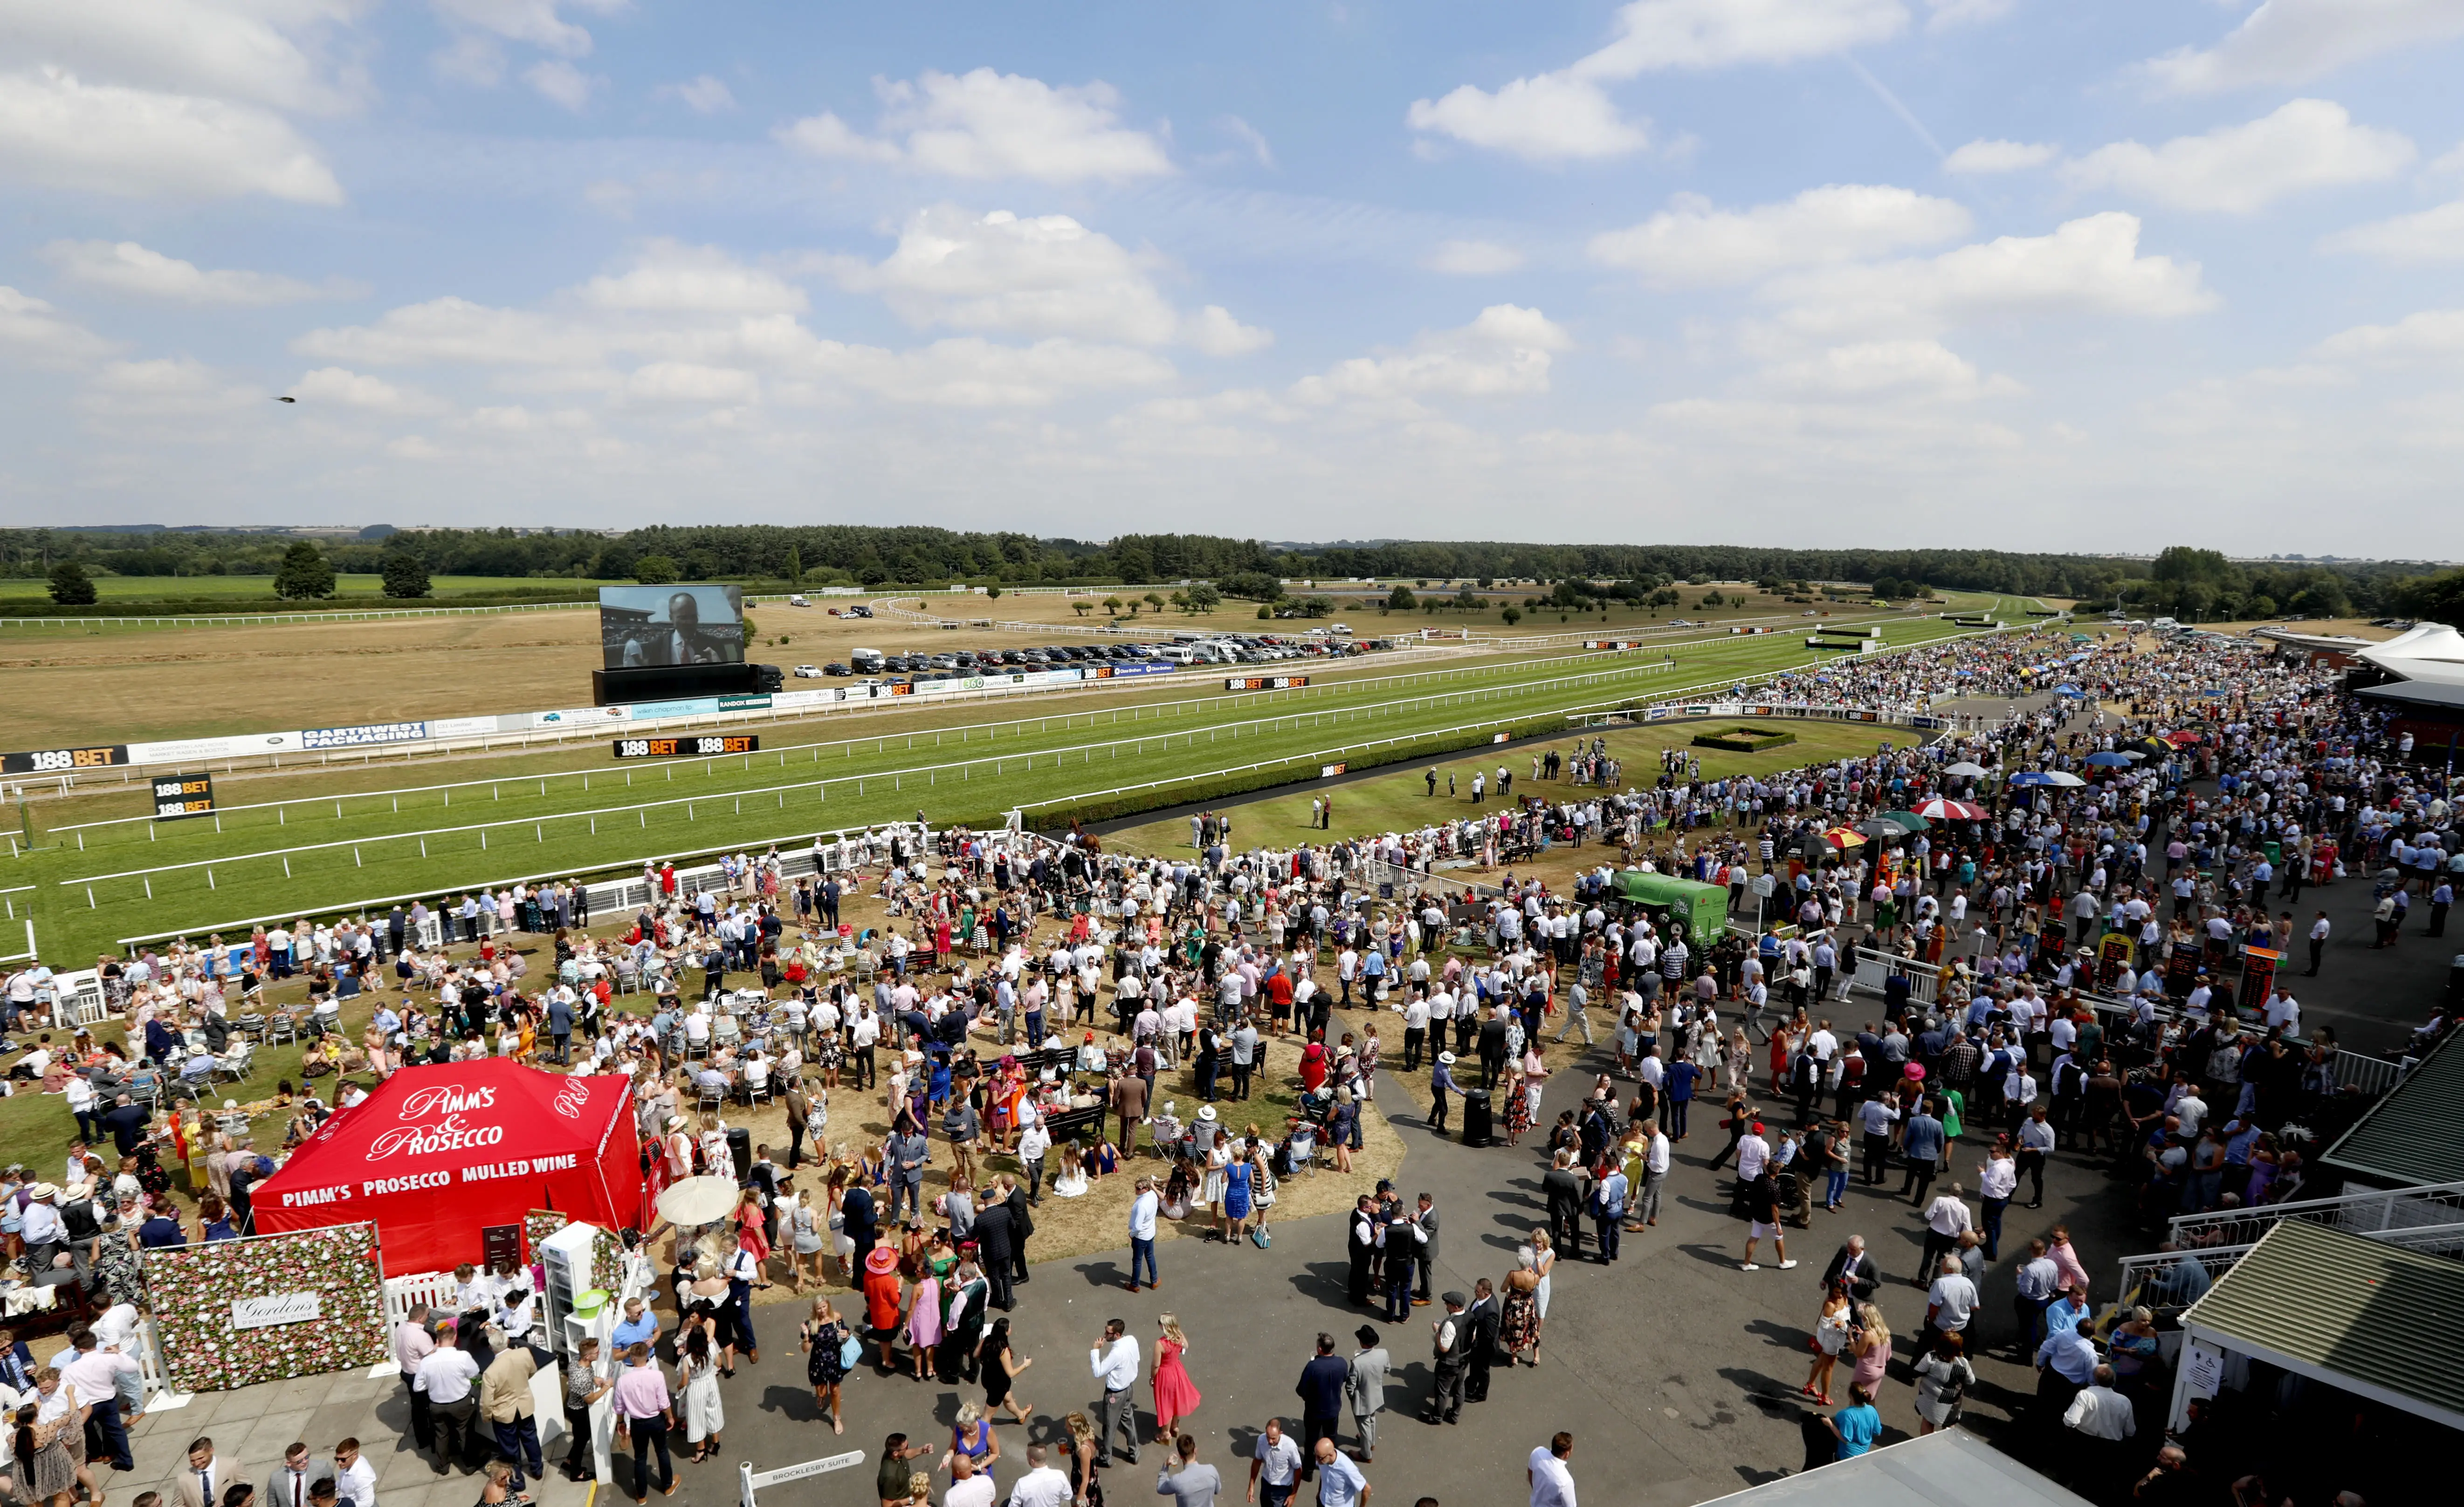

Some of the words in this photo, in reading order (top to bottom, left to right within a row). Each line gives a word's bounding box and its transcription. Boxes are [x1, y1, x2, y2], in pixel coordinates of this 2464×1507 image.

[1084, 668, 1111, 679] 188BET
[964, 678, 984, 689] 360
[1230, 679, 1263, 690] 188BET
[1273, 678, 1305, 688] 188BET
[876, 685, 909, 698] 188BET
[303, 722, 422, 739] GARTHWEST
[1494, 732, 1510, 743] 188BET
[304, 730, 424, 747] PACKAGING
[697, 738, 750, 753] 188BET
[621, 740, 677, 756] 188BET
[32, 748, 113, 770] 188BET
[1322, 764, 1346, 777] 188BET
[156, 781, 209, 797] 188BET
[158, 800, 211, 815] 188BET
[436, 1114, 469, 1134] &
[366, 1125, 502, 1161] PROSECCO
[282, 1184, 351, 1207] PIMM'S
[363, 1170, 451, 1196] PROSECCO
[462, 1161, 530, 1183] MULLED
[532, 1154, 577, 1173] WINE
[239, 1298, 312, 1319] Gordon's
[242, 1315, 286, 1325] PREMIUM
[773, 1463, 826, 1480] BROCKLESBY
[828, 1458, 850, 1467] SUITE
